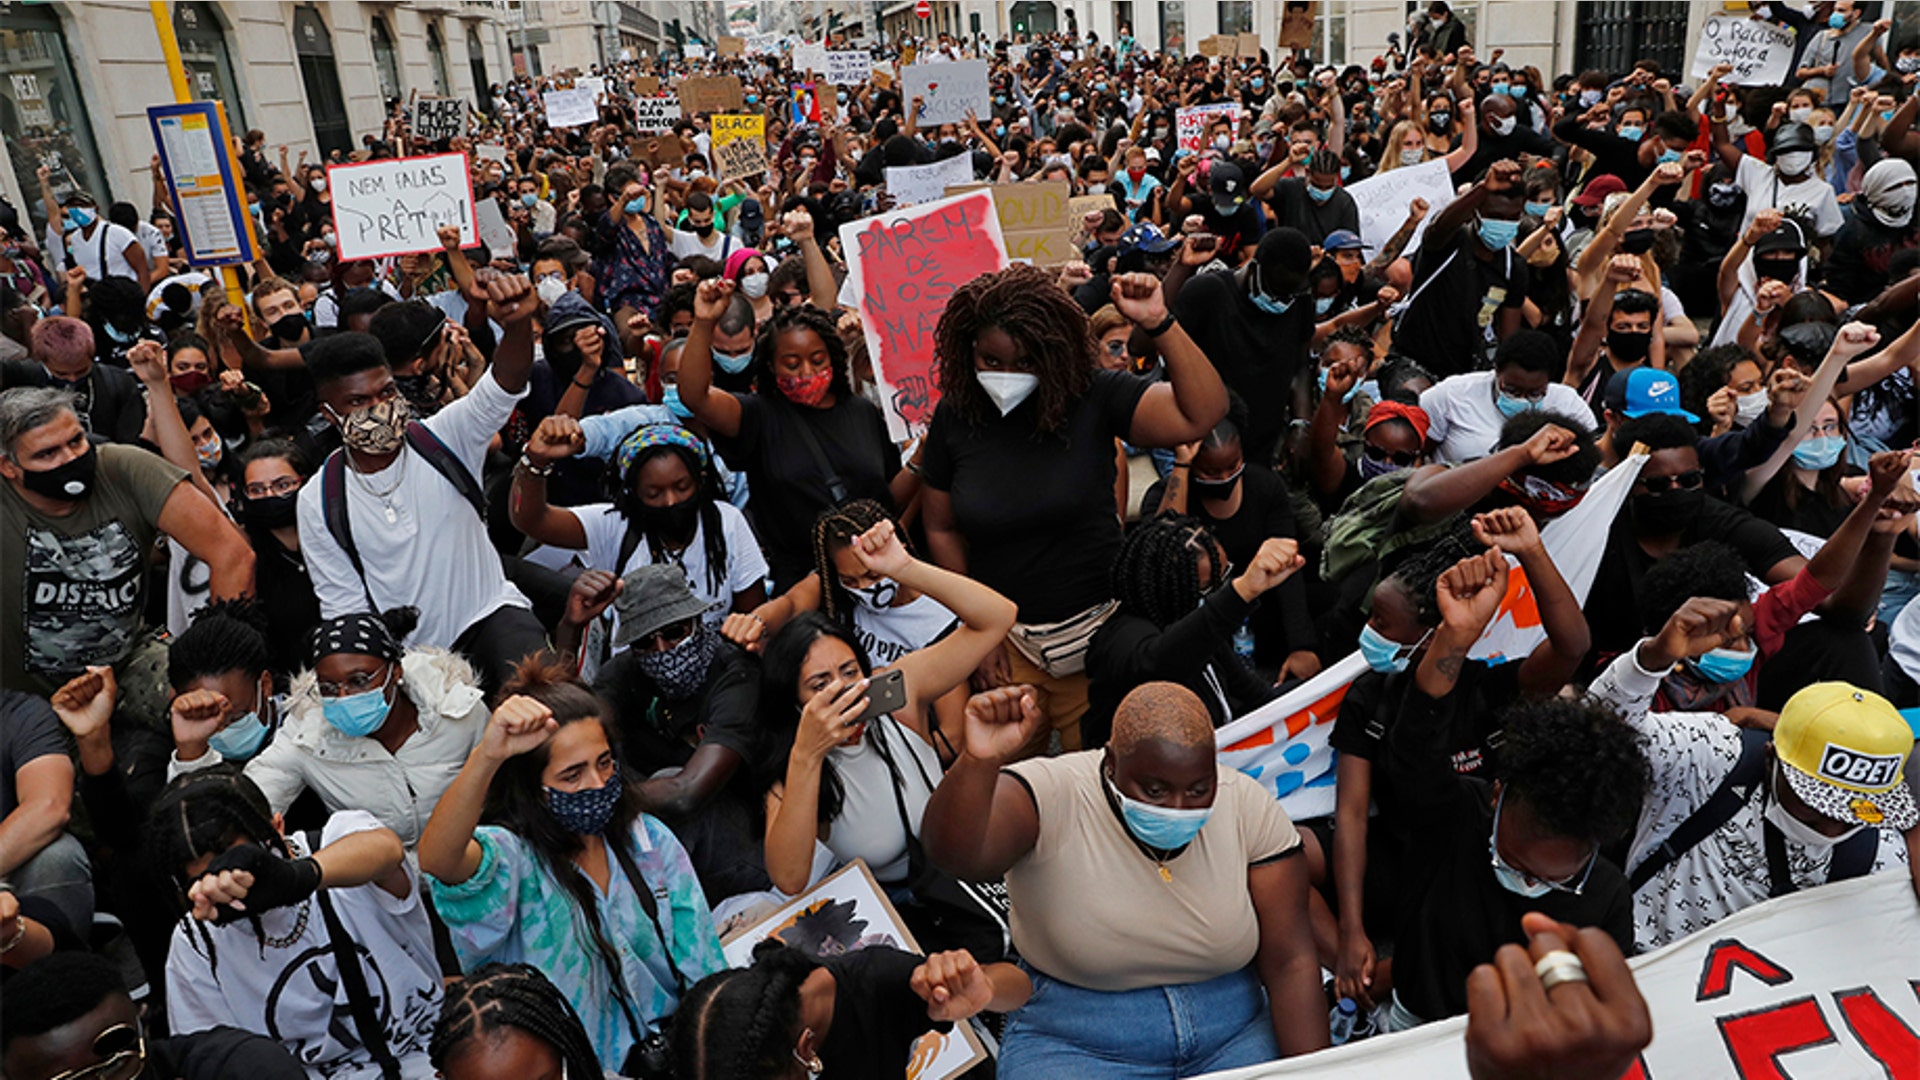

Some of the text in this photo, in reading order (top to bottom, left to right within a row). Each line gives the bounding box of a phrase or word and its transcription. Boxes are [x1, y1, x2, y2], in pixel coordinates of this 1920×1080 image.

[1706, 19, 1794, 48] O Racismo
[1708, 39, 1769, 63] Sufoca
[417, 99, 463, 115] BLACK
[349, 165, 447, 198] NEM FALAS
[855, 205, 973, 262] PAREM
[905, 251, 942, 277] DE
[865, 272, 957, 316] NOS
[1826, 752, 1898, 783] OBEY
